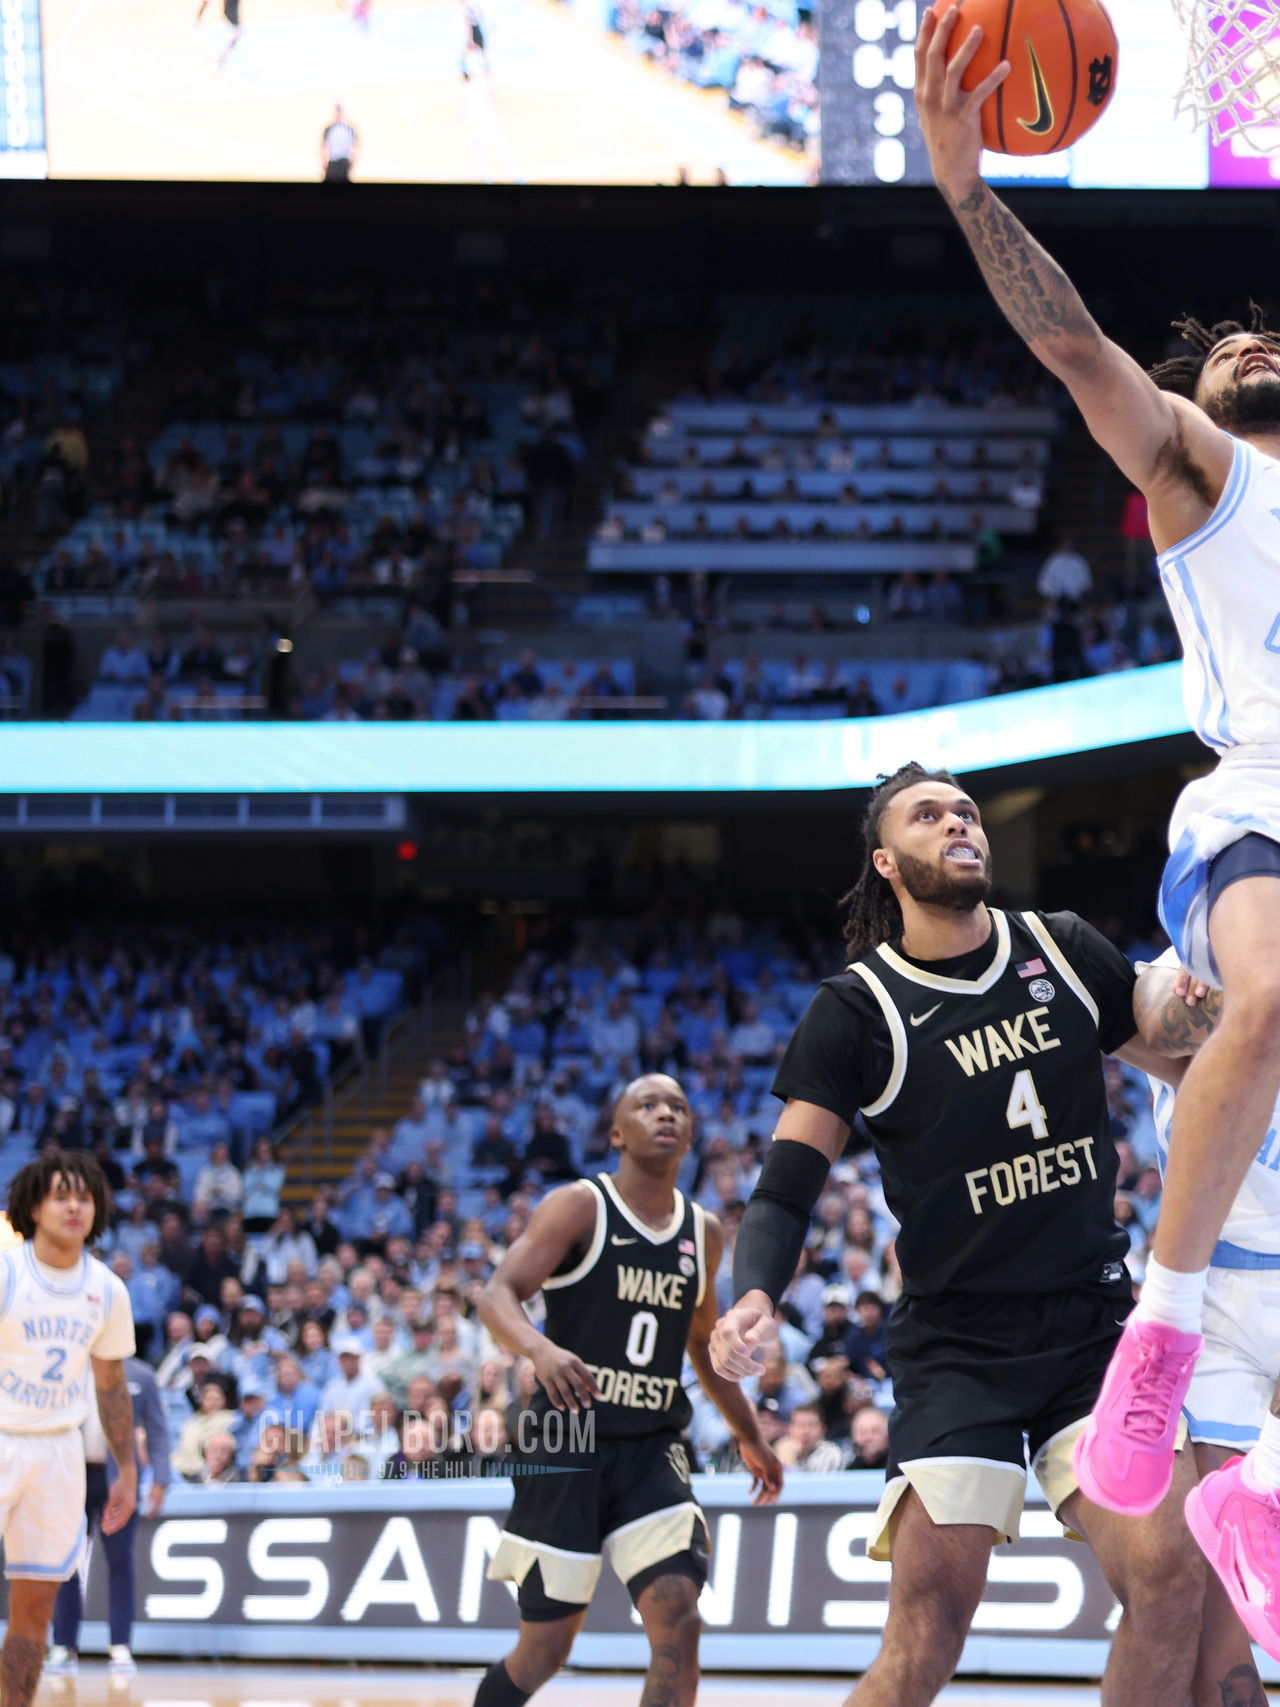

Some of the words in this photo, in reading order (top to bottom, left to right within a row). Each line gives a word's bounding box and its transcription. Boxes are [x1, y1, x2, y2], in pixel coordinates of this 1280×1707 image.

[944, 1006, 1062, 1077] WAKE
[1006, 1069, 1050, 1140] 4
[964, 1136, 1098, 1215] FOREST
[617, 1264, 688, 1310] WAKE
[42, 1347, 66, 1381] 2
[625, 1310, 659, 1367] 0
